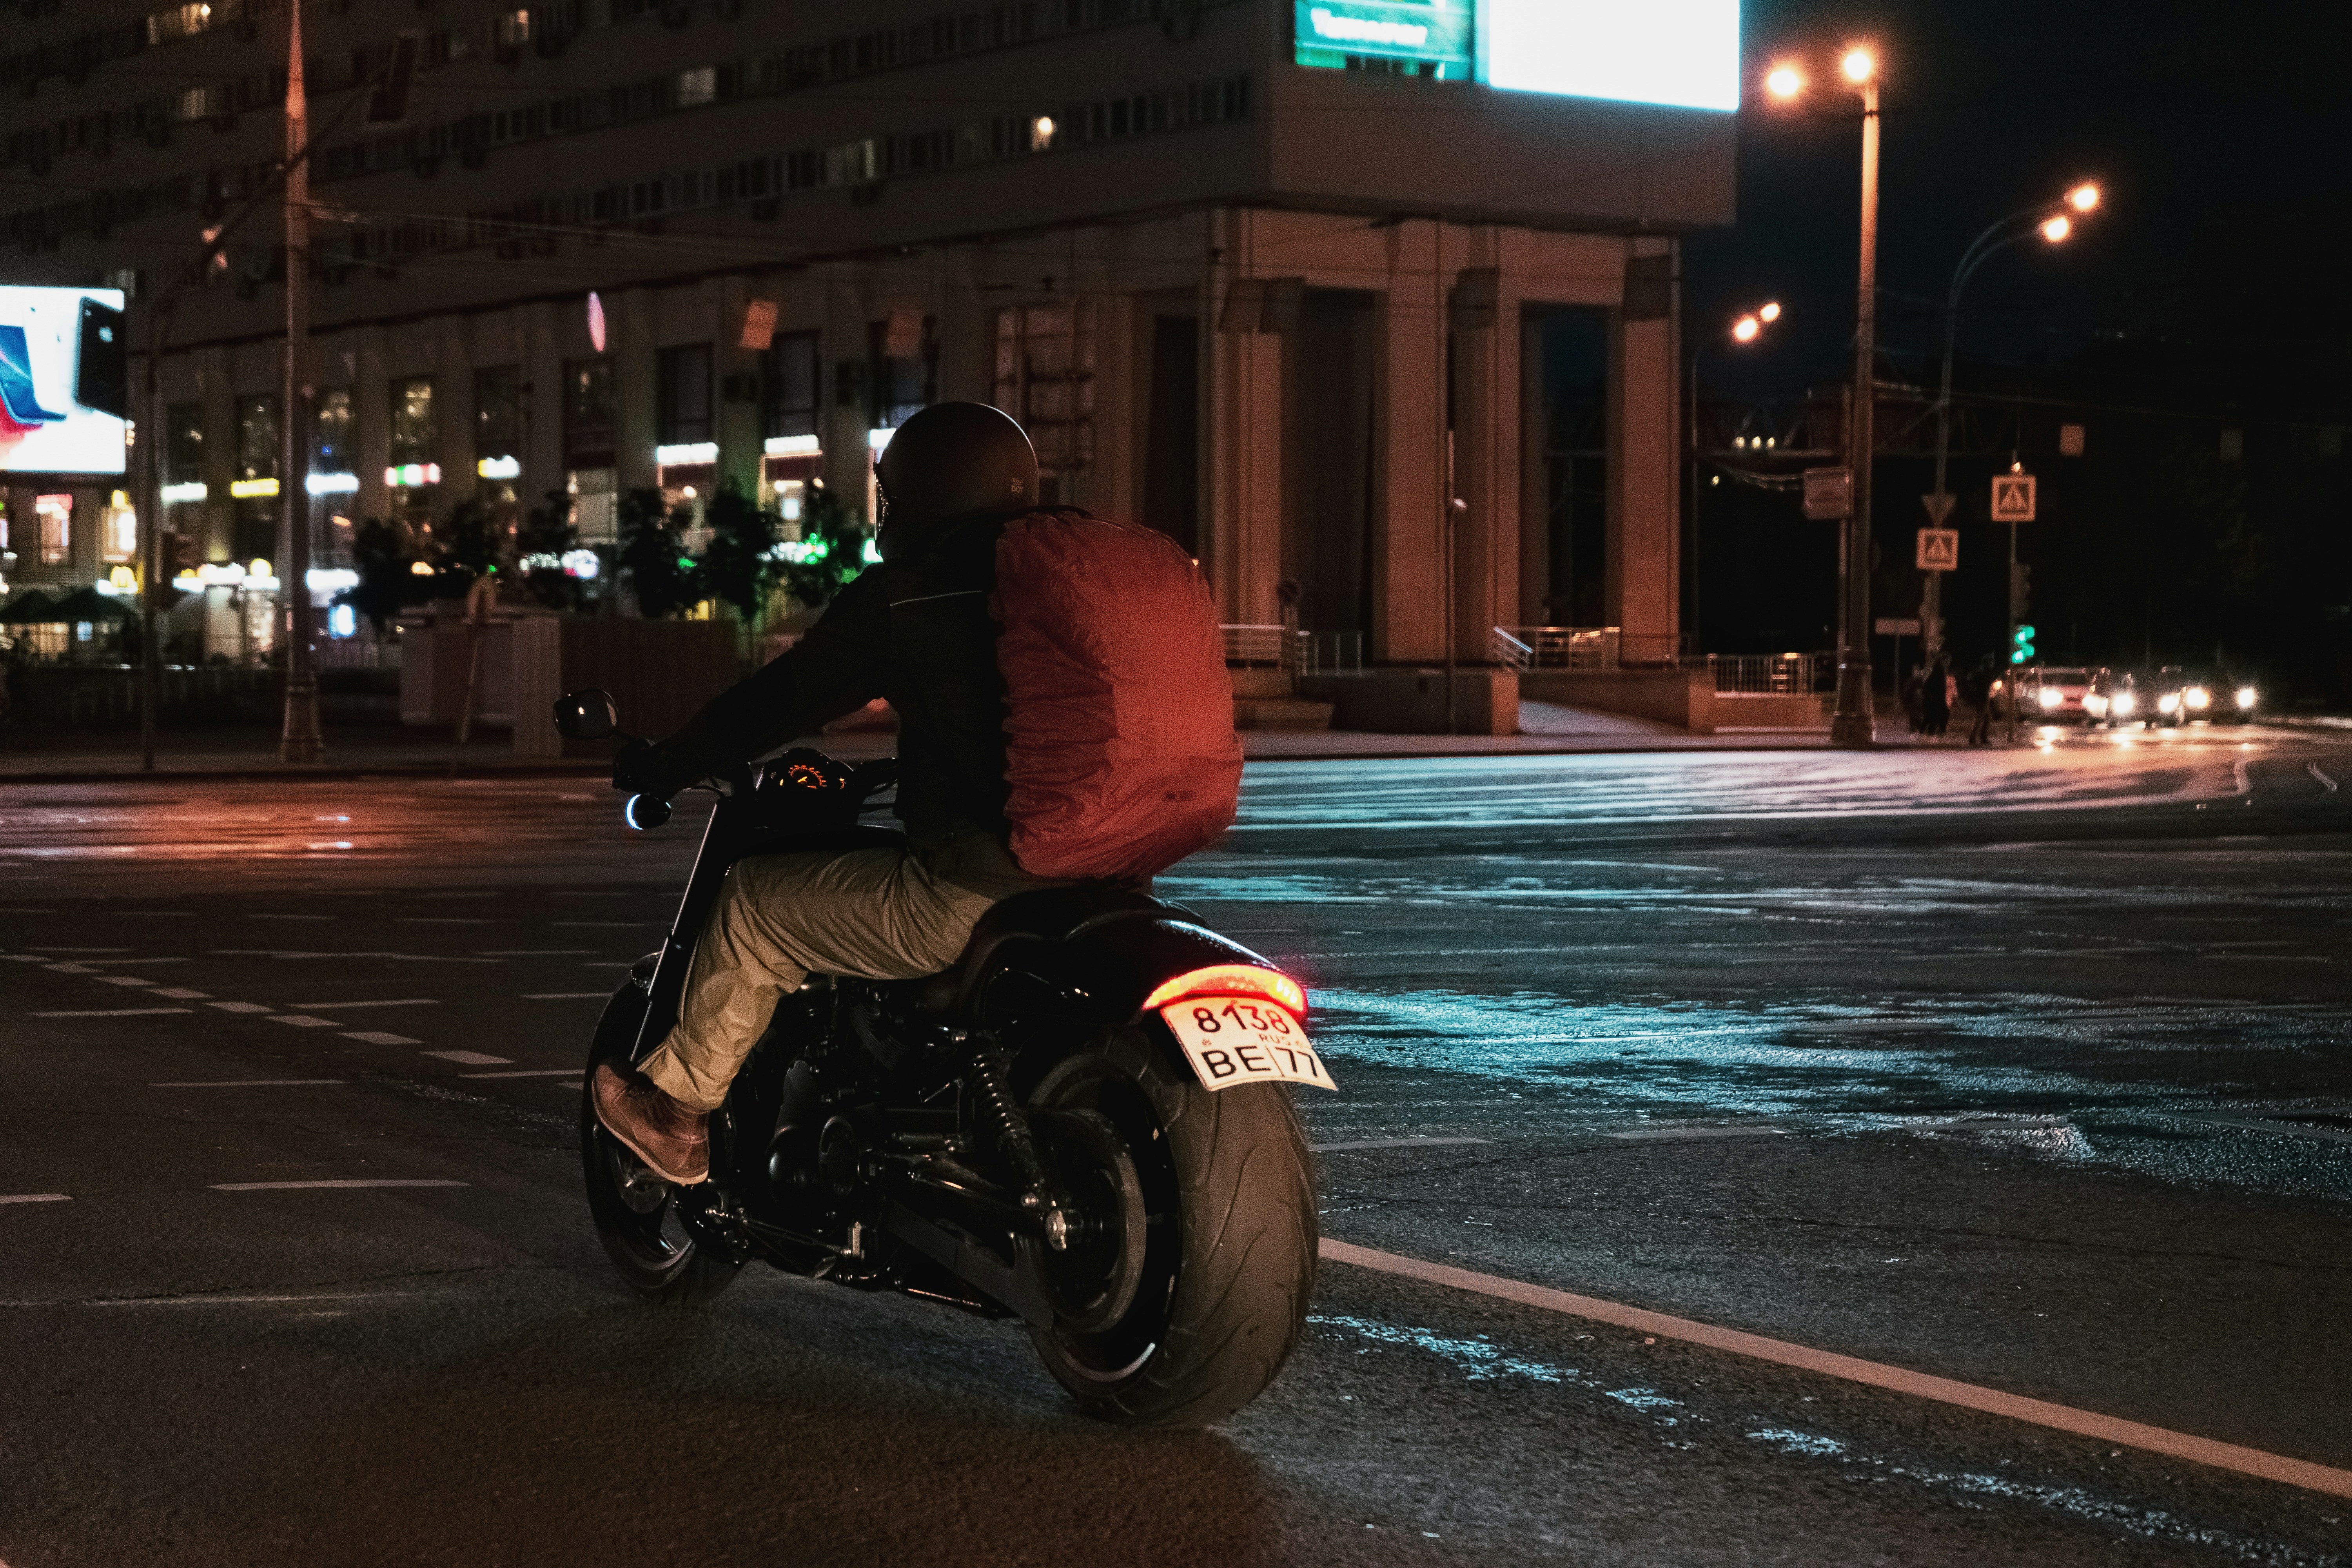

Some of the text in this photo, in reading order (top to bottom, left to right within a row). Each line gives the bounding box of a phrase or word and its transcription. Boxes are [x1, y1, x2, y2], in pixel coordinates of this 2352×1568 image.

[1193, 1004, 1290, 1034] 8138
[1258, 1034, 1291, 1045] RUS
[1201, 1046, 1318, 1078] BE 77
